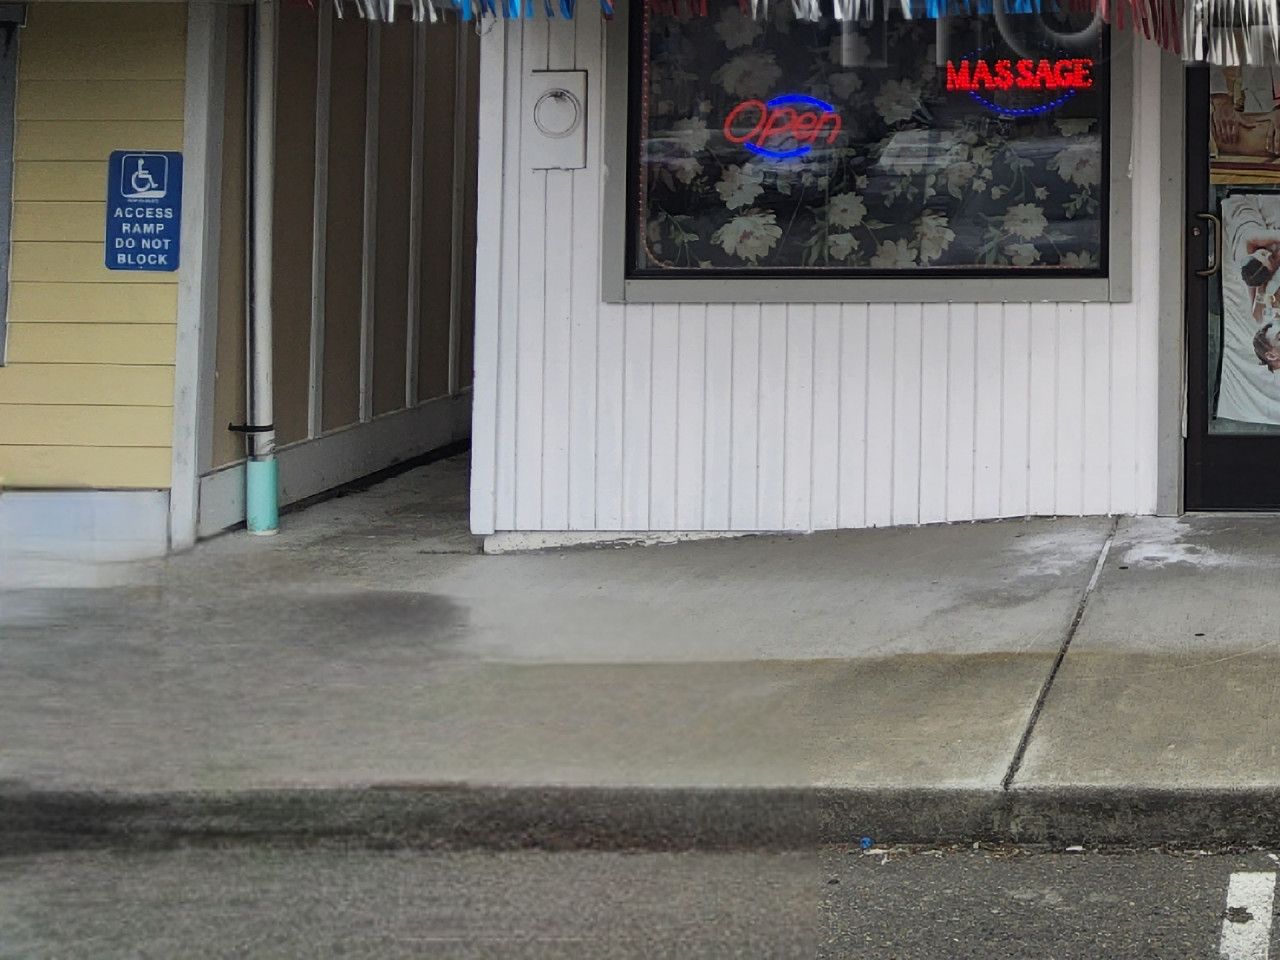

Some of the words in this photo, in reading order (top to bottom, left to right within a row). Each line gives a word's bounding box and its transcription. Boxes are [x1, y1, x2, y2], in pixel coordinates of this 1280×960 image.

[946, 57, 1094, 92] MASSAGE
[723, 99, 842, 146] Open
[114, 207, 173, 218] ACCESS
[122, 223, 164, 235] RAMP
[115, 238, 135, 249] DO
[141, 239, 171, 250] NOT
[117, 253, 167, 265] BLOCK
